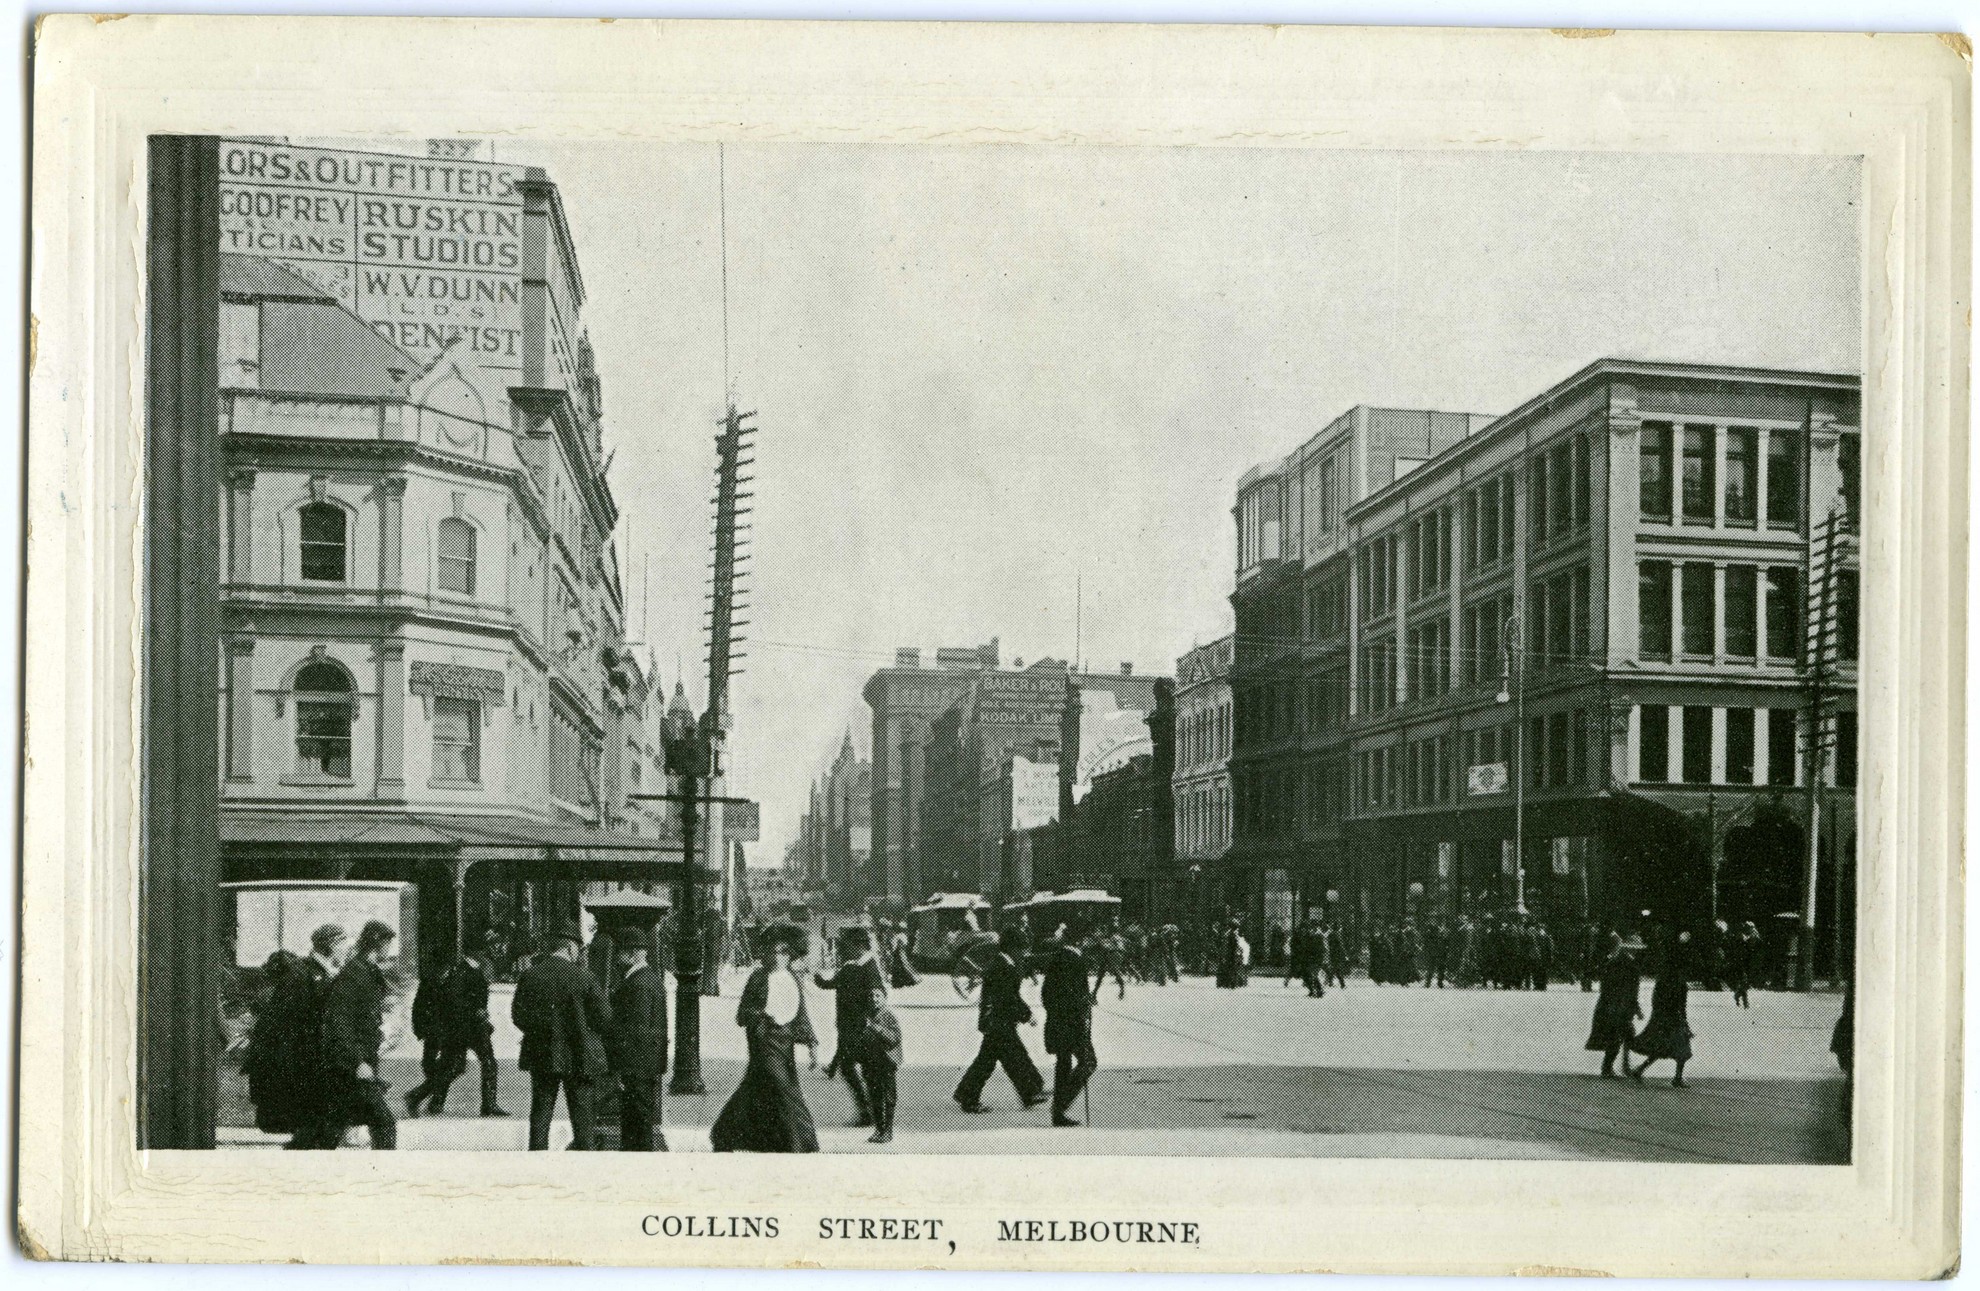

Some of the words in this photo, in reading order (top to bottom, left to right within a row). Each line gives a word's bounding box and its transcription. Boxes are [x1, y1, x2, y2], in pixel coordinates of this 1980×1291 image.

[220, 189, 350, 224] GODFREY
[363, 201, 519, 238] RUSKIN
[220, 229, 346, 255] TICIANS
[363, 232, 519, 269] STUDIOS
[983, 677, 1029, 690] BAKER
[980, 711, 1027, 723] KODAK
